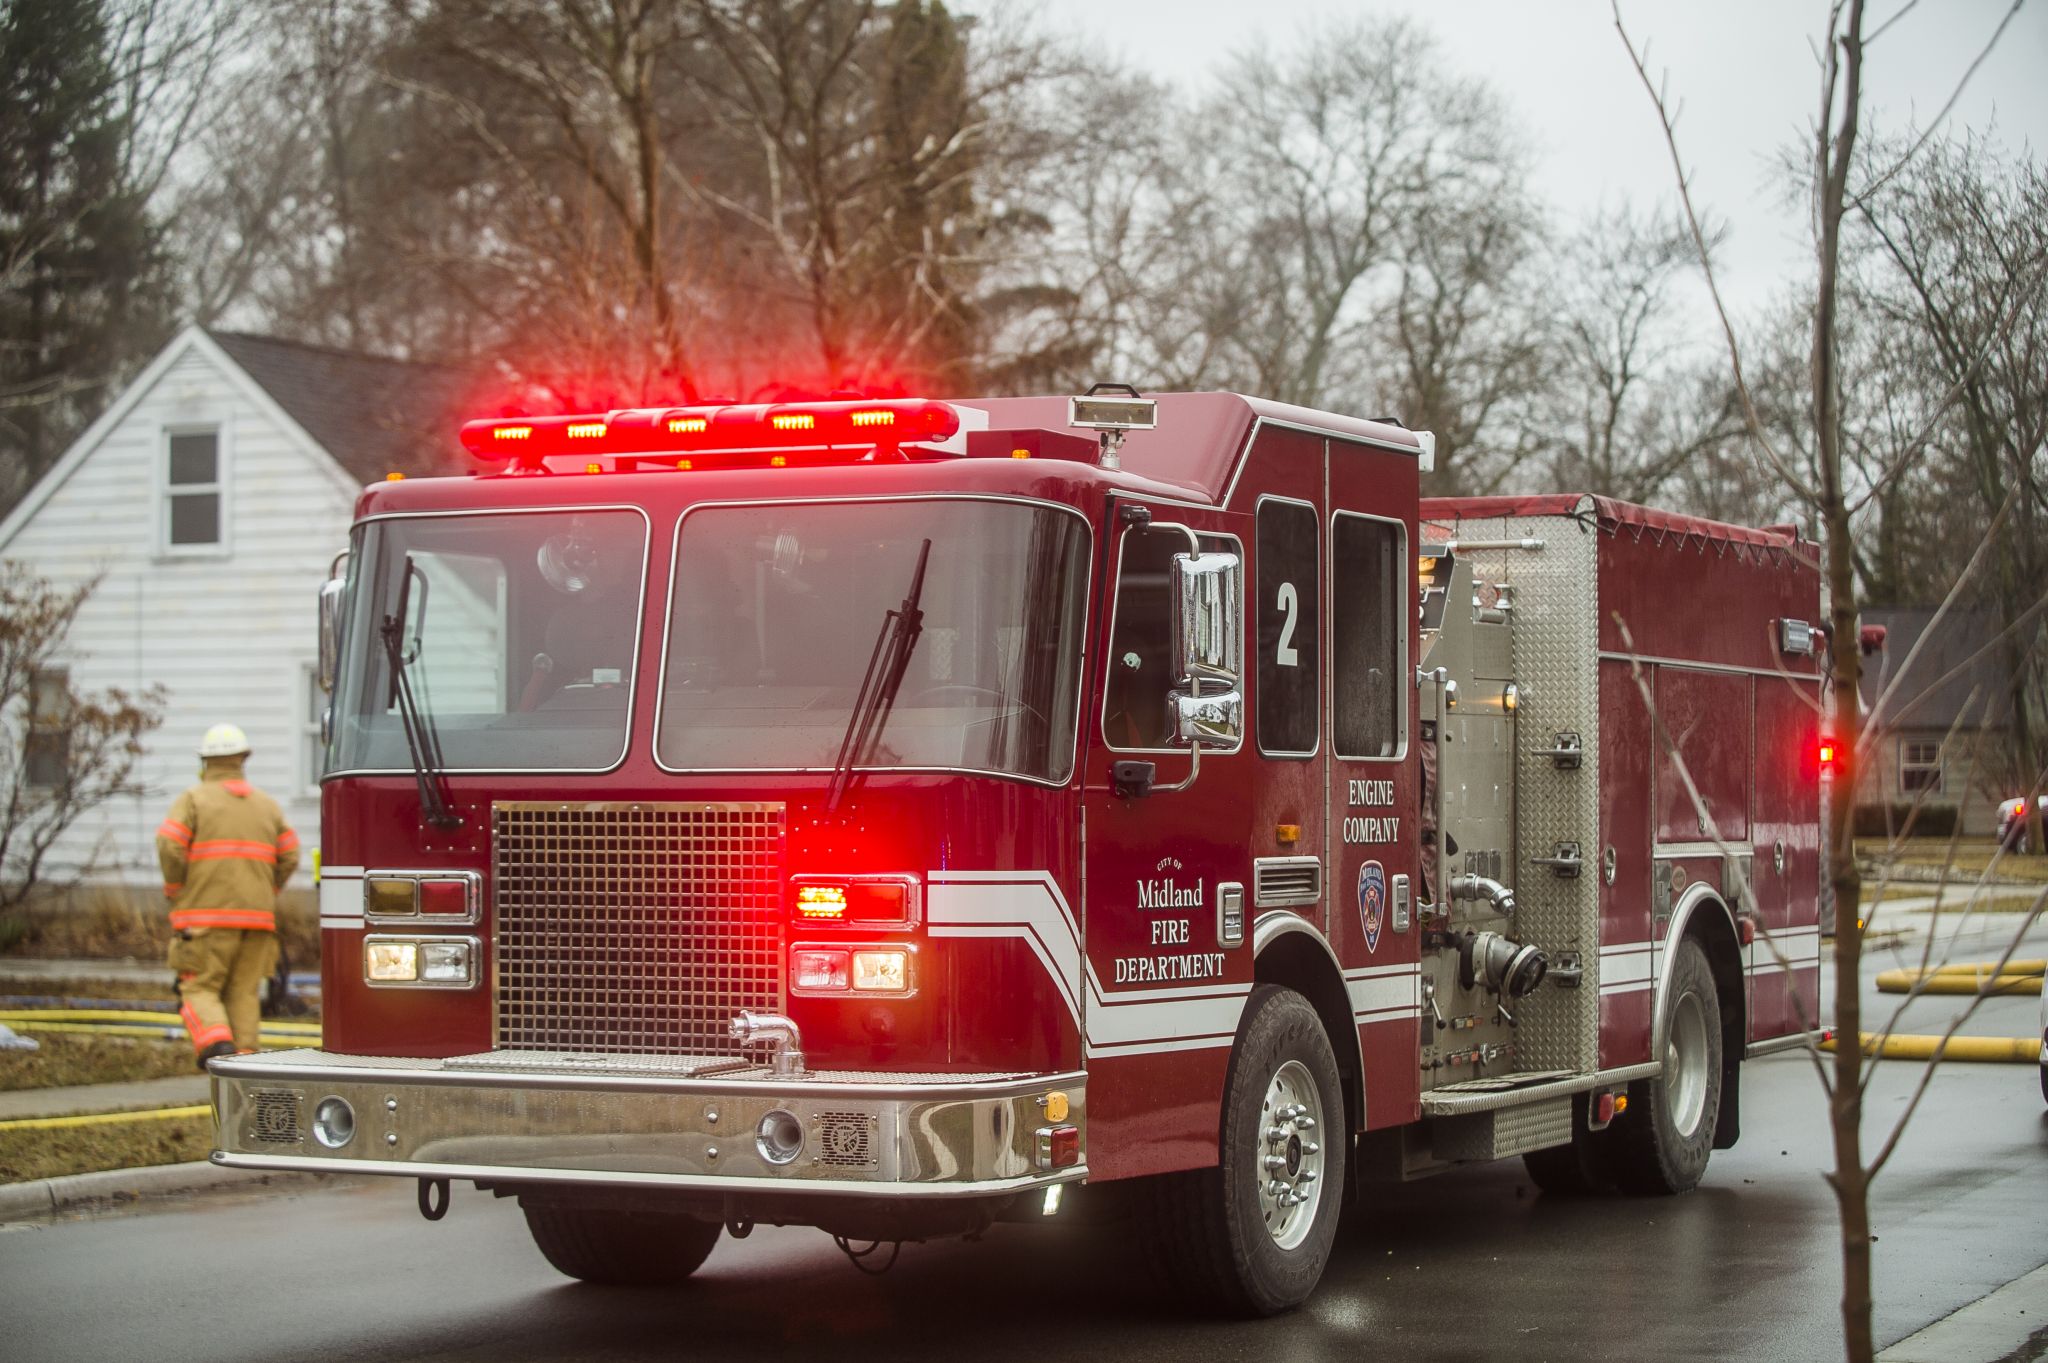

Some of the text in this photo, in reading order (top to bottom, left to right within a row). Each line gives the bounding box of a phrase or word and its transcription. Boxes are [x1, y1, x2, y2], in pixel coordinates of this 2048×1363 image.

[1277, 582, 1298, 666] 2
[1349, 780, 1394, 806] ENGINE
[1343, 817, 1400, 843] COMPANY
[1157, 857, 1183, 872] CITY OF
[1137, 877, 1203, 908] Midland
[1152, 919, 1190, 945] FIRE
[1115, 953, 1226, 983] DEPARTMENT
